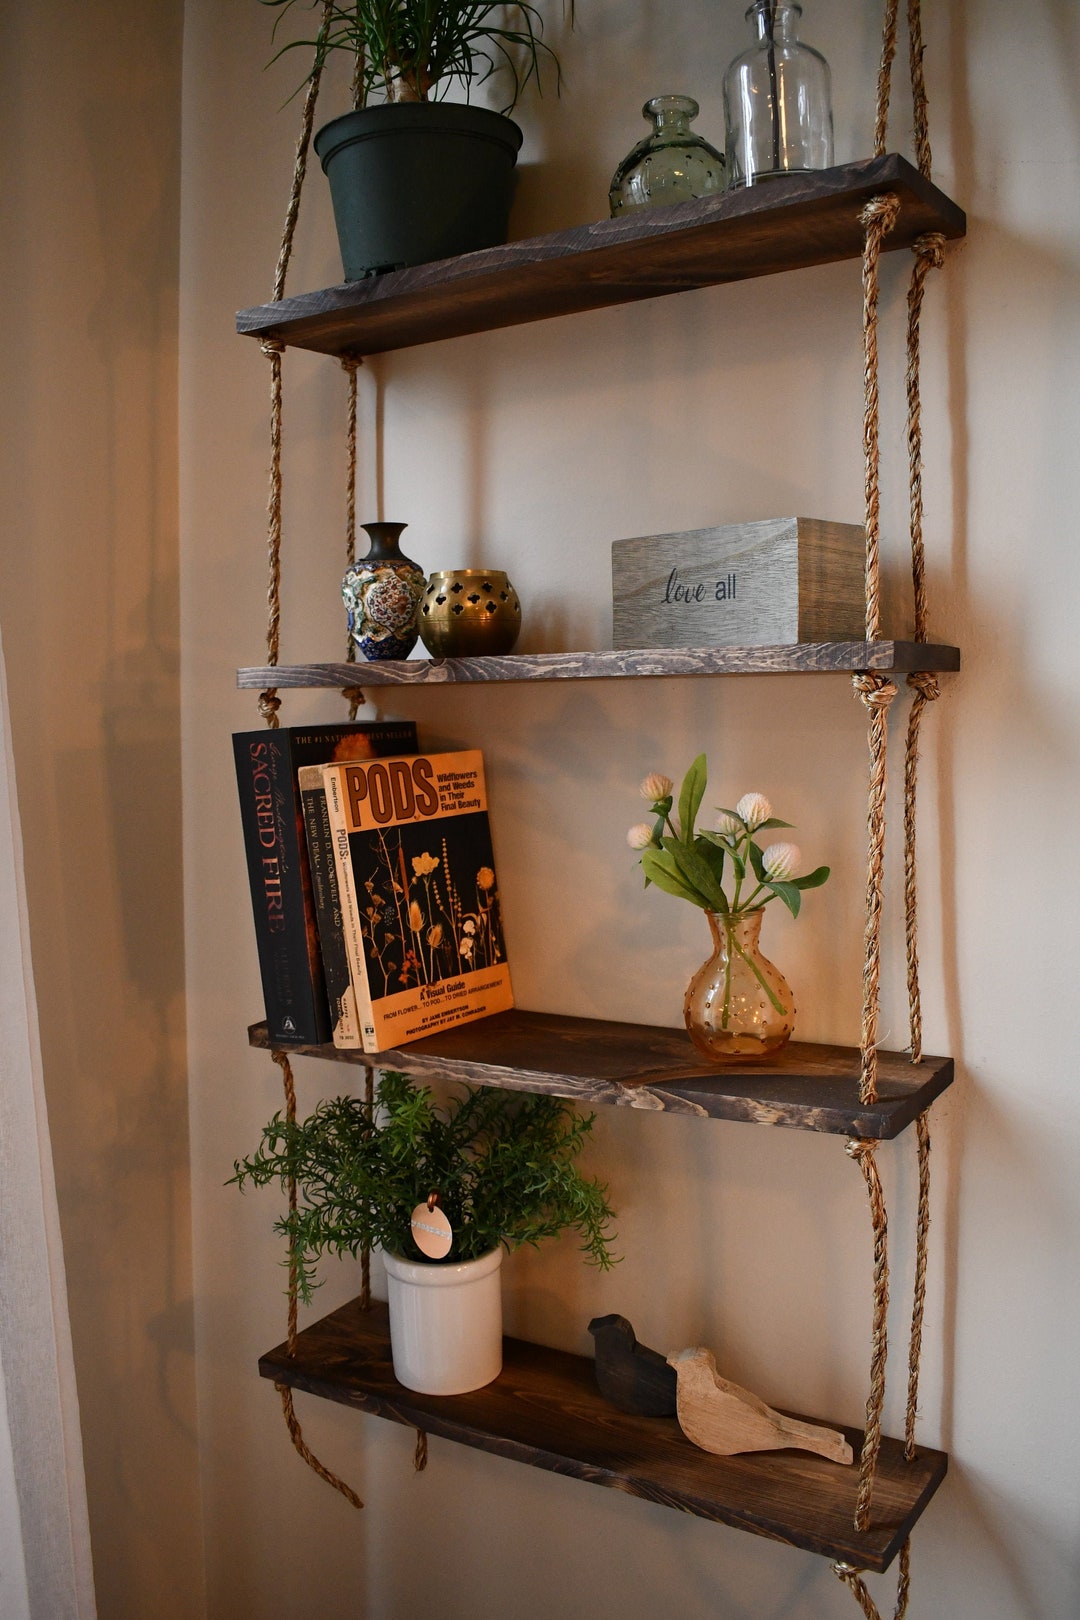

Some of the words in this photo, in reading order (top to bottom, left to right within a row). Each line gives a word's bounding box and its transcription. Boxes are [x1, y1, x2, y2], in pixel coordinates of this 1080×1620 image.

[660, 567, 707, 604] love
[715, 573, 736, 601] all
[295, 736, 312, 745] THE
[436, 770, 478, 783] Wildflowers
[438, 784, 451, 792] and
[452, 780, 475, 790] Weeds
[249, 742, 277, 849] SACRED
[330, 776, 341, 813] Embertson
[345, 758, 439, 827] PODS
[439, 794, 446, 802] in
[447, 790, 465, 801] Their
[306, 796, 315, 814] THE
[440, 801, 457, 811] Final
[457, 798, 481, 809] Beauty
[308, 818, 318, 838] NEW
[336, 828, 349, 861] PODS:
[319, 795, 331, 838] FRANKLIN
[326, 853, 338, 904] ROOSEVELT
[333, 907, 341, 927] AND
[261, 855, 286, 934] FIRE
[383, 1011, 398, 1020] FROM
[452, 990, 468, 999] DRIED
[468, 979, 503, 995] ARRANGEMENT
[425, 986, 446, 999] Visual
[446, 981, 466, 993] Guide
[429, 1012, 441, 1021] JANE
[441, 1005, 469, 1017] EMBERTSON
[405, 1021, 440, 1036] PHOTOGRAPHY
